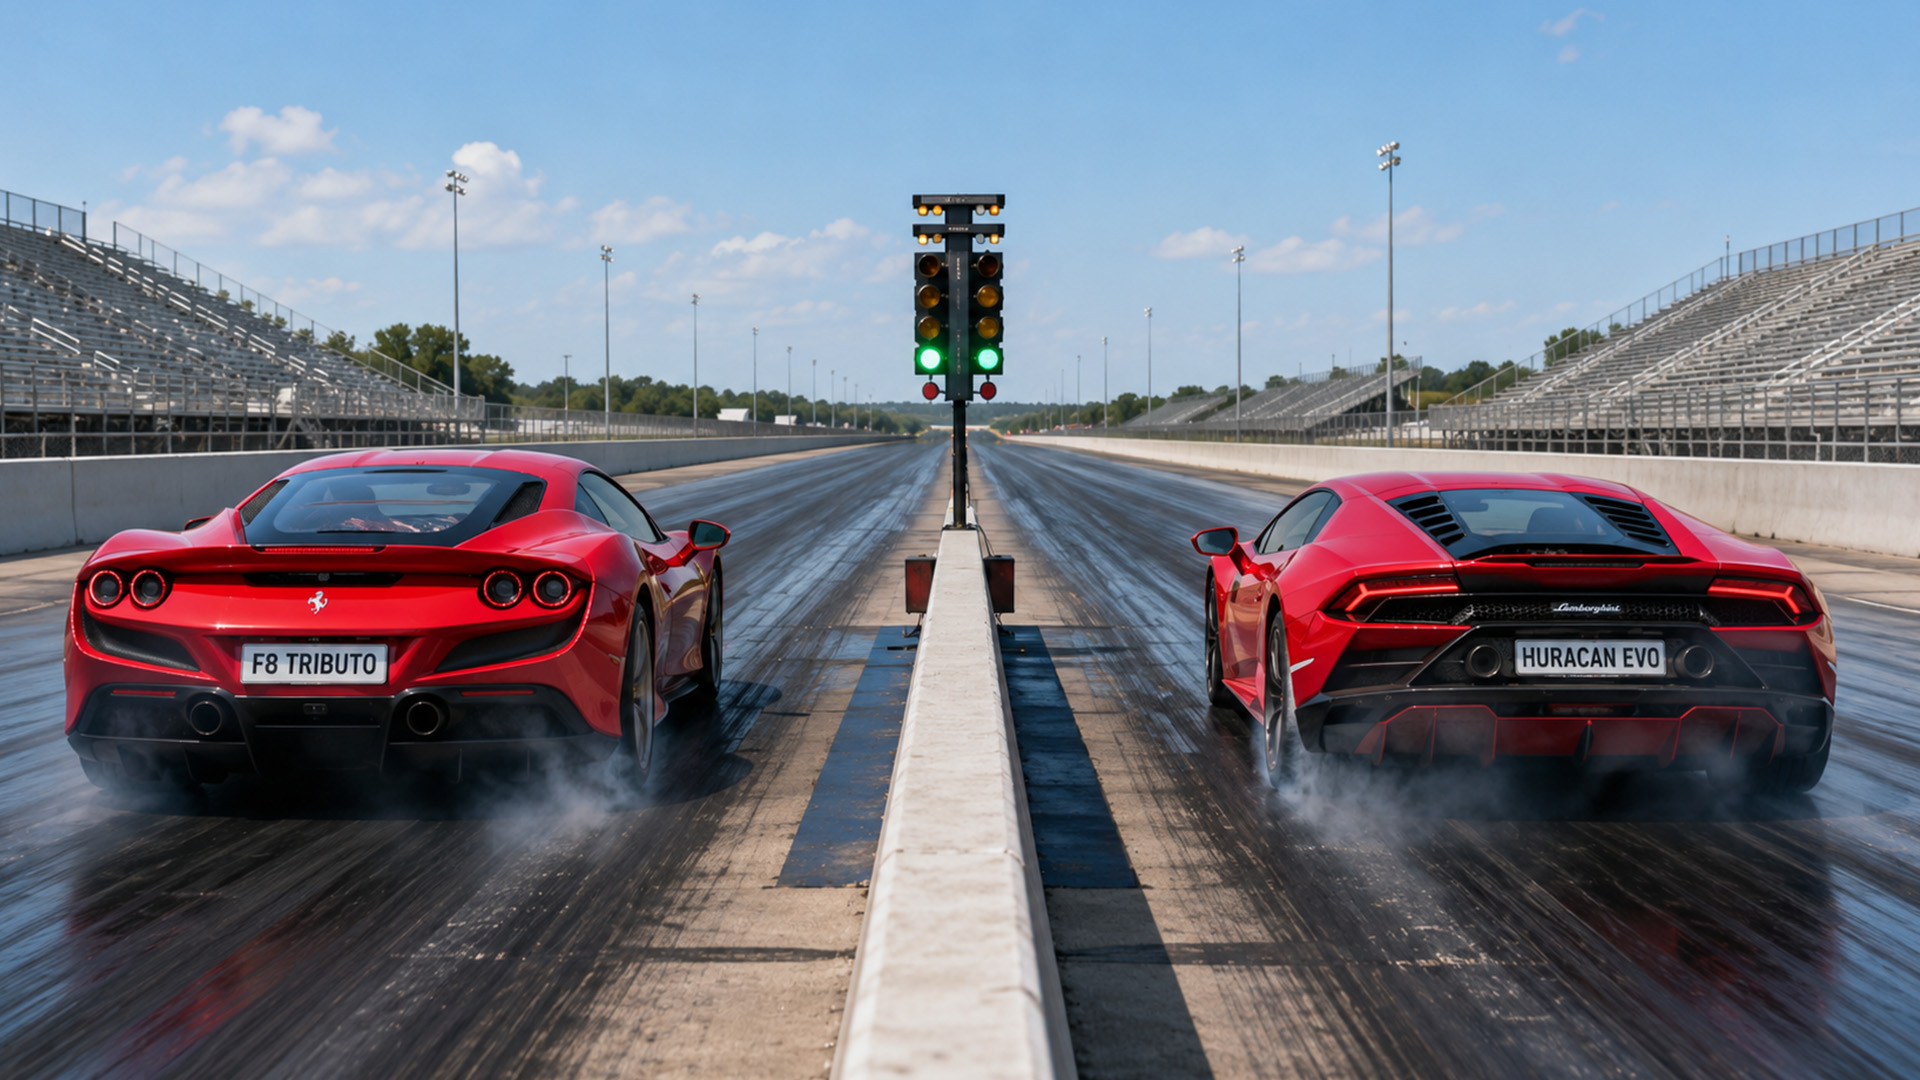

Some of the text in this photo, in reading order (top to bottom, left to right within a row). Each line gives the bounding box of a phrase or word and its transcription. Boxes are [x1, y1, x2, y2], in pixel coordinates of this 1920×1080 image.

[1553, 602, 1621, 614] Lamborghini
[252, 653, 377, 675] F8 TRIBUTO
[1522, 647, 1660, 668] HURACAN EVO
